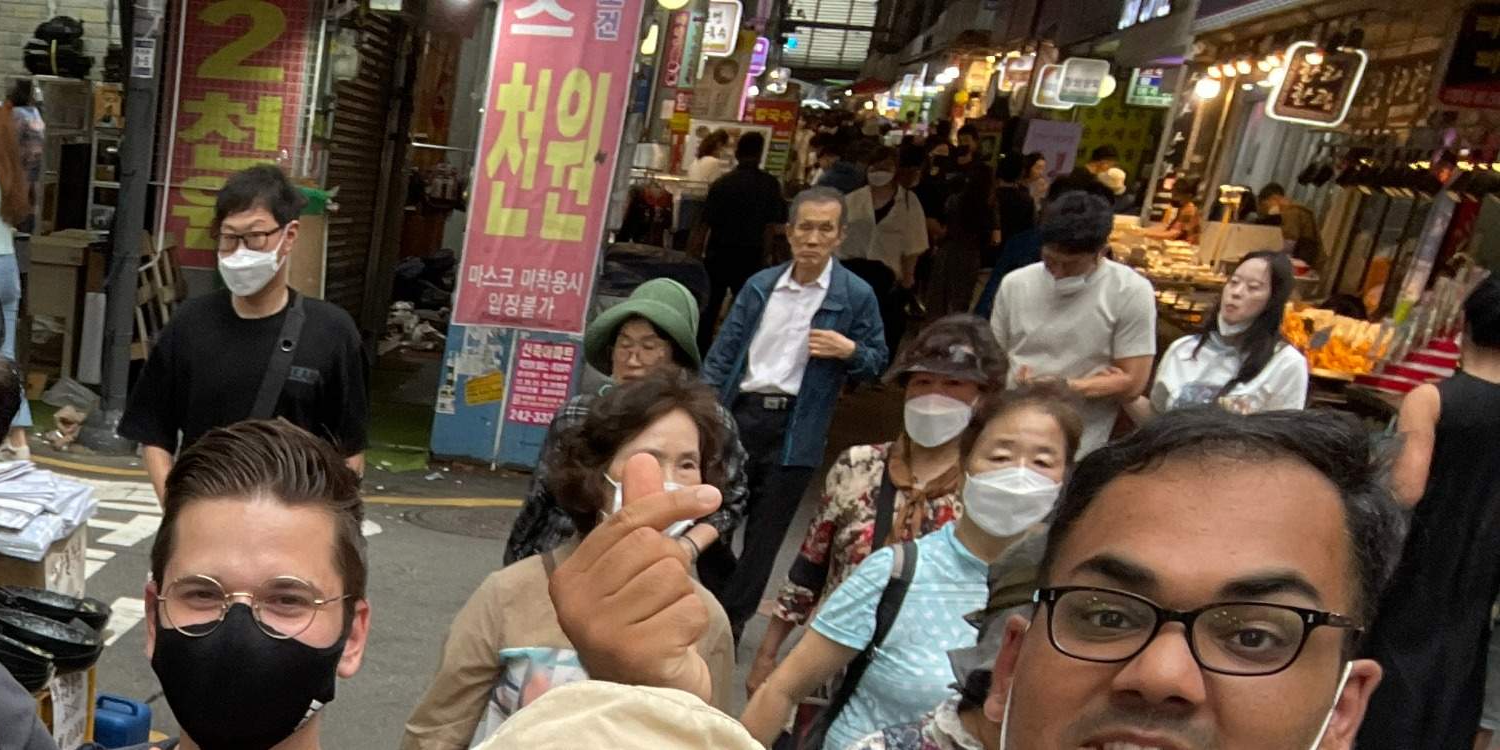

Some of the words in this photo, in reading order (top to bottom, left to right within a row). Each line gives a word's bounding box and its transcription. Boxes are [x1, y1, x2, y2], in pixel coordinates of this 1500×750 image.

[484, 62, 612, 242] 천원
[467, 264, 515, 289] 마스크
[520, 268, 584, 297] 미착용시
[487, 291, 555, 321] 입장불가
